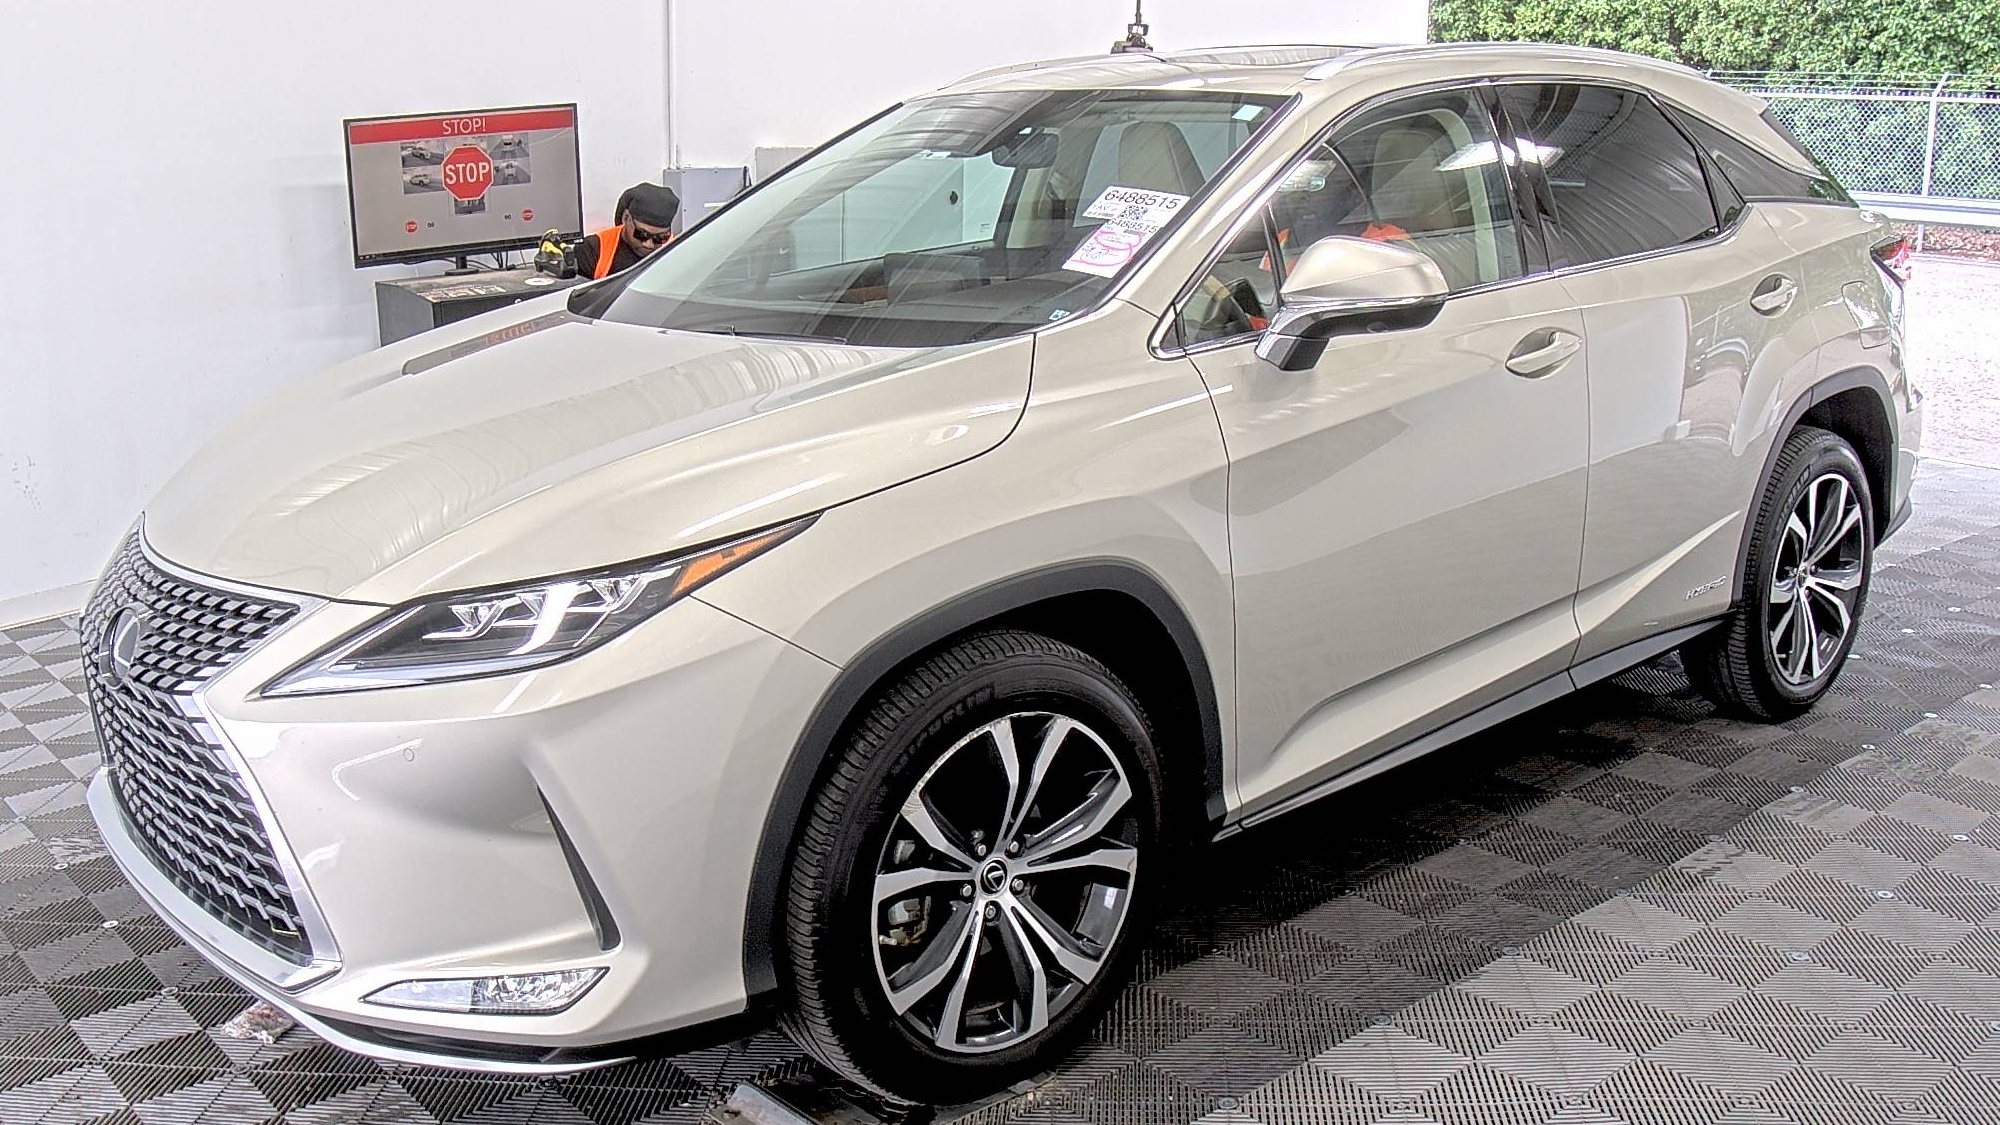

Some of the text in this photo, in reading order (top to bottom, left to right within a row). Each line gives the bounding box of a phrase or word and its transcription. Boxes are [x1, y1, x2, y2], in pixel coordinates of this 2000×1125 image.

[442, 117, 487, 135] STOP!
[445, 162, 490, 185] STOP
[1104, 189, 1182, 210] 6488515
[1106, 217, 1159, 234] 6488515
